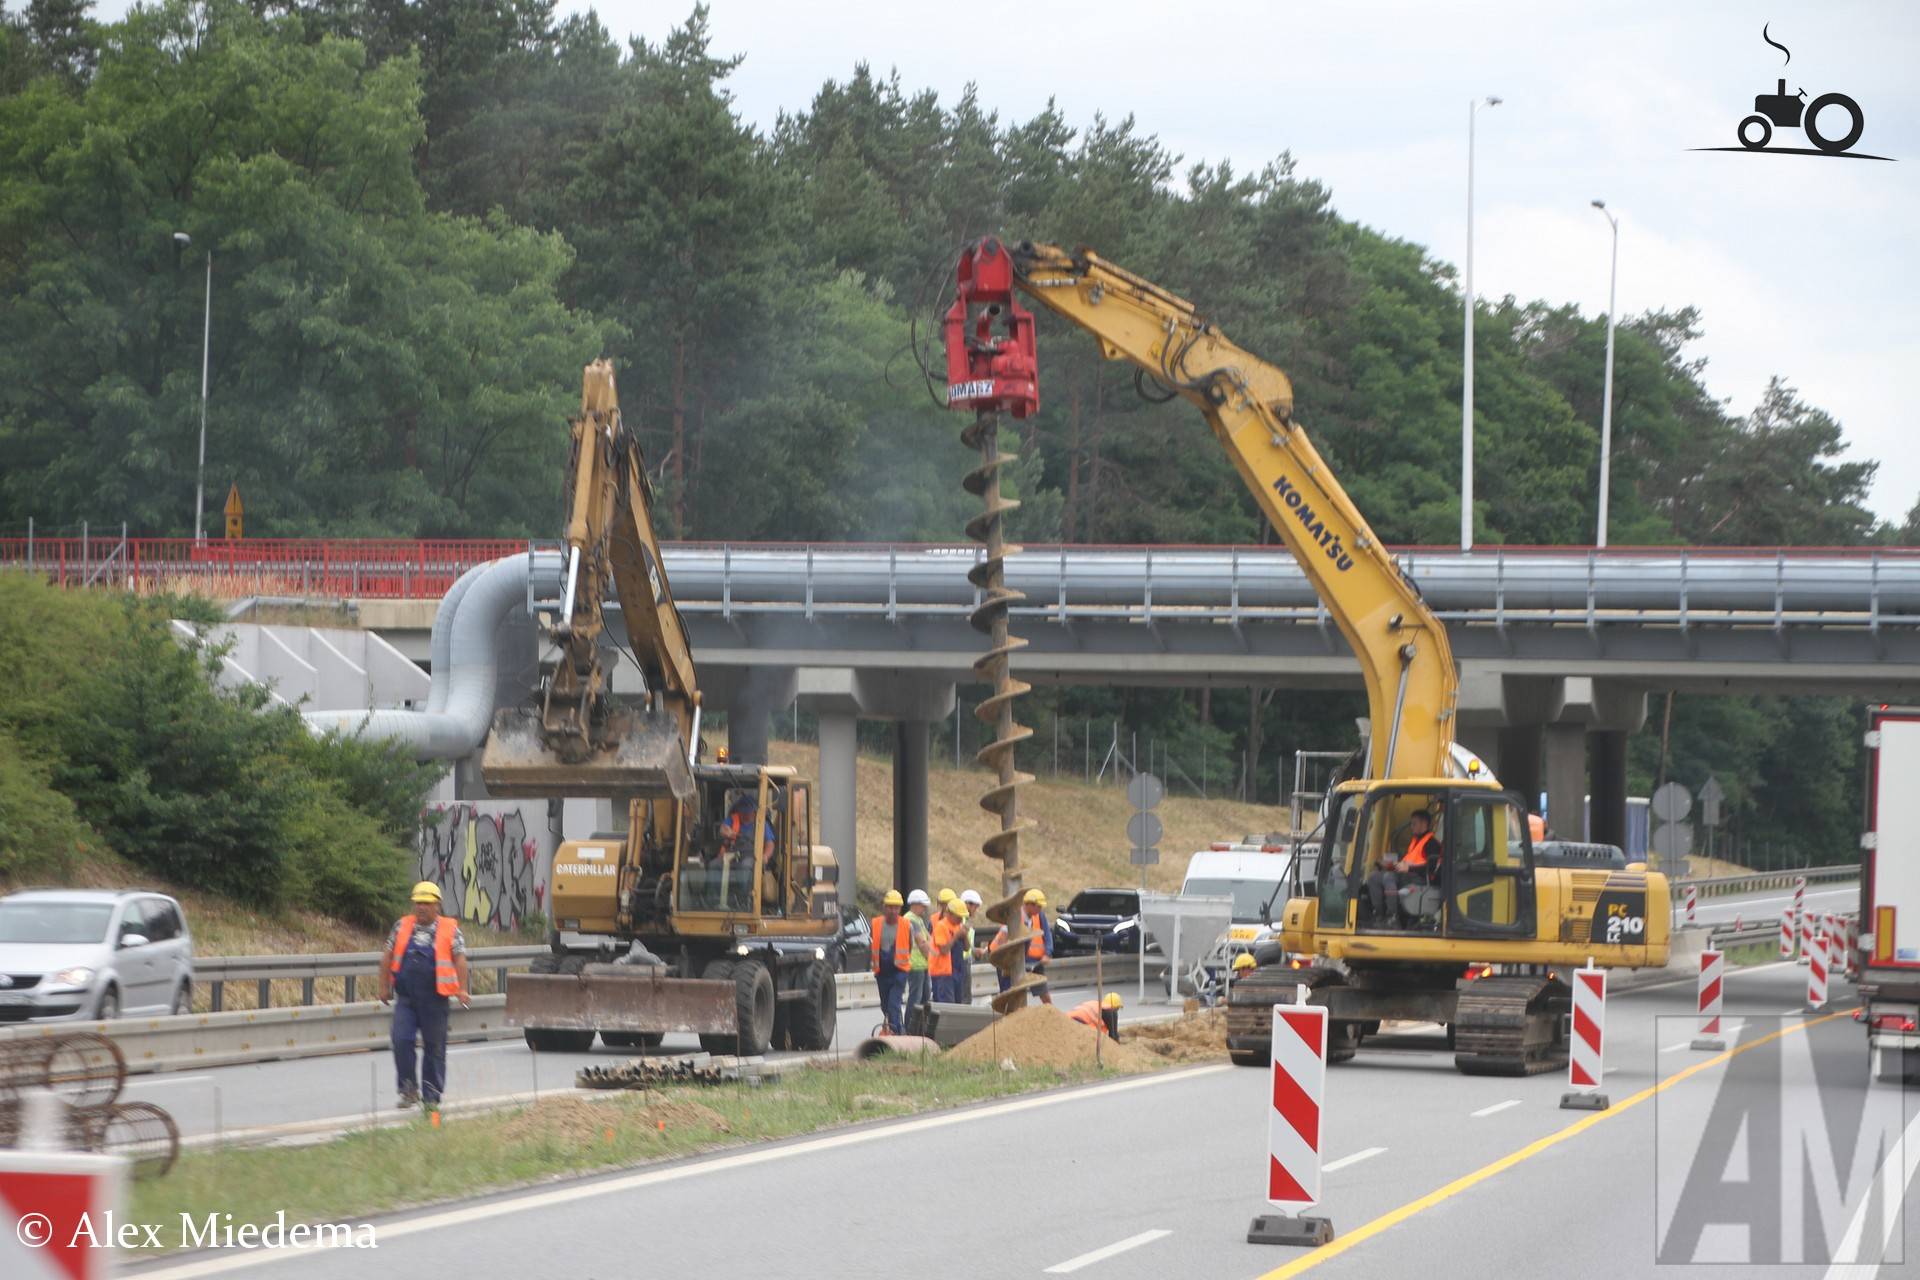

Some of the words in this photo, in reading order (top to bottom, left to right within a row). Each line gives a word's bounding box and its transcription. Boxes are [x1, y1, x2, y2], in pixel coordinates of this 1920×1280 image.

[1273, 475, 1354, 571] KOMATSU
[556, 864, 616, 876] CATERPILLAR
[1608, 904, 1628, 917] PC
[1607, 916, 1644, 933] 210
[1607, 933, 1620, 943] LC
